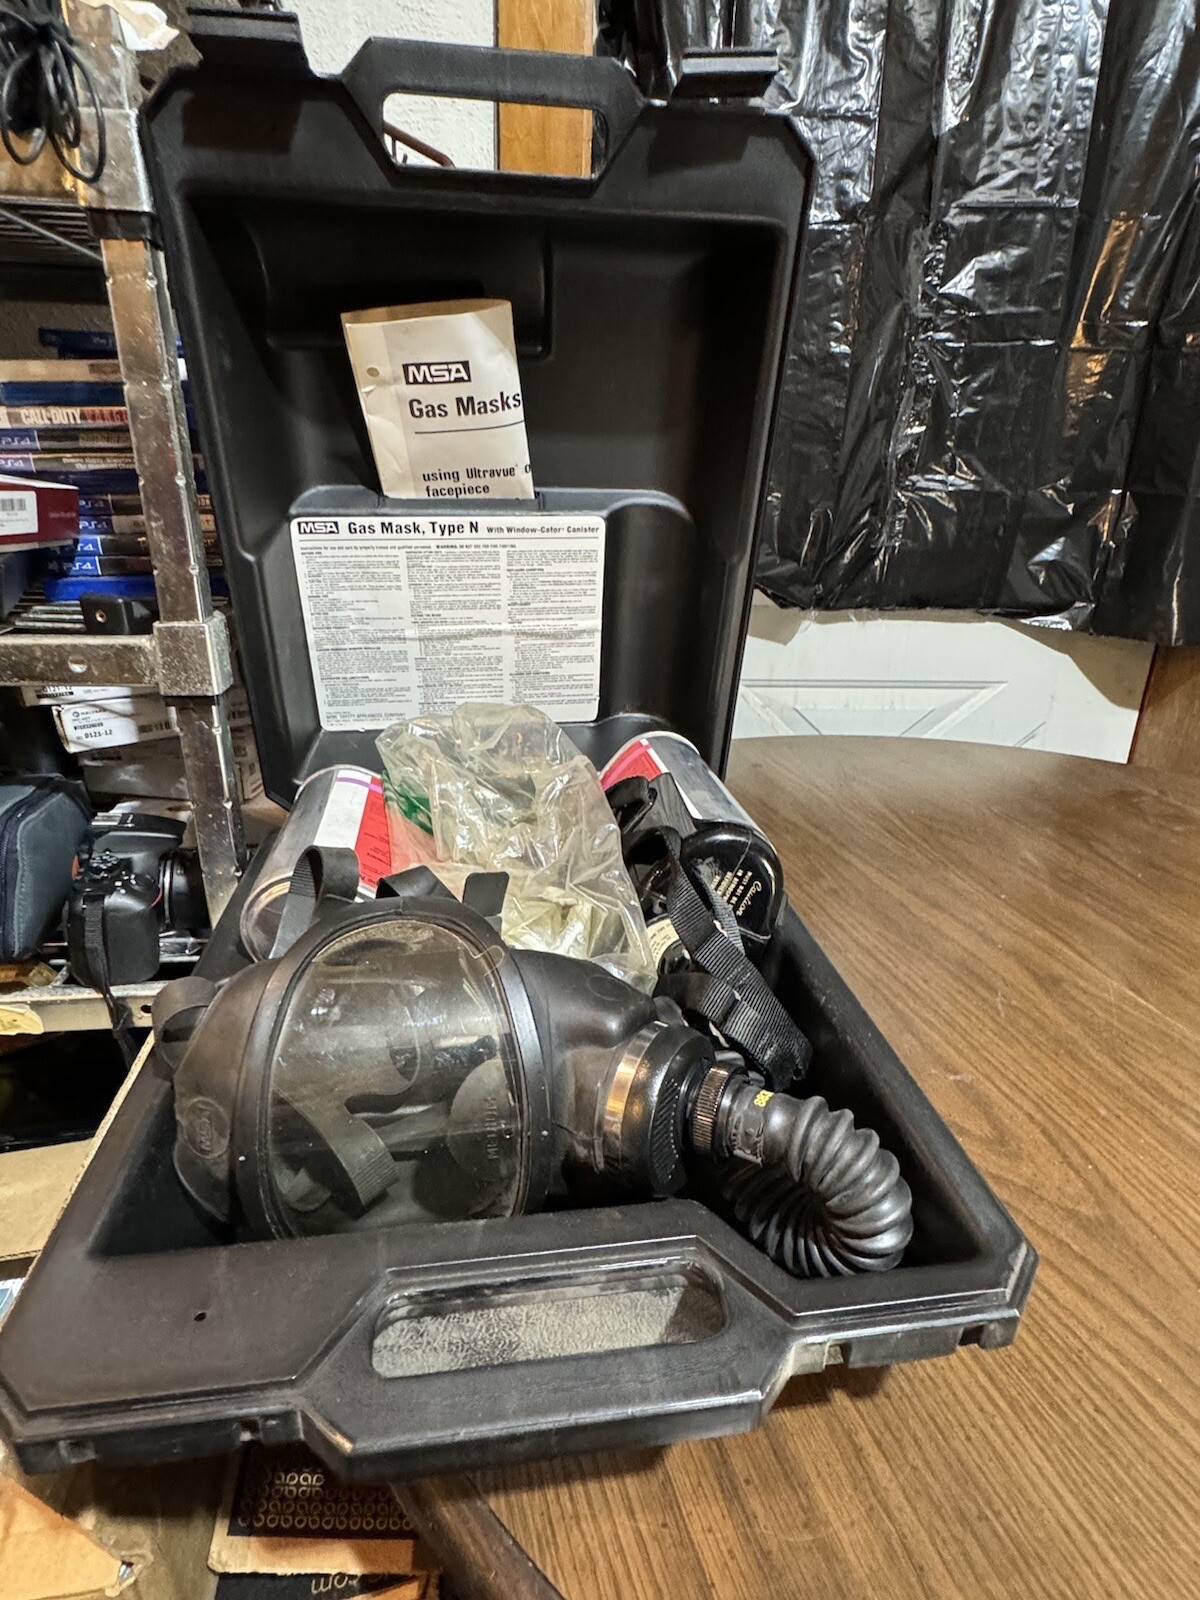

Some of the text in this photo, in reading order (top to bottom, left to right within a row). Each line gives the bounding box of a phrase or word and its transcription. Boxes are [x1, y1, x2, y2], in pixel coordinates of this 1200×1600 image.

[403, 361, 471, 385] MSA
[408, 391, 522, 419] Gas Masks
[52, 407, 81, 424] DUTY
[422, 468, 460, 483] using
[425, 484, 490, 498] facepiece
[297, 521, 340, 535] MSA
[347, 521, 376, 535] Gas
[381, 521, 425, 537] Mask,
[429, 521, 465, 537] Type
[469, 521, 479, 534] N
[566, 525, 600, 533] Canister
[84, 729, 113, 739] 0121-12
[736, 880, 762, 916] Caution
